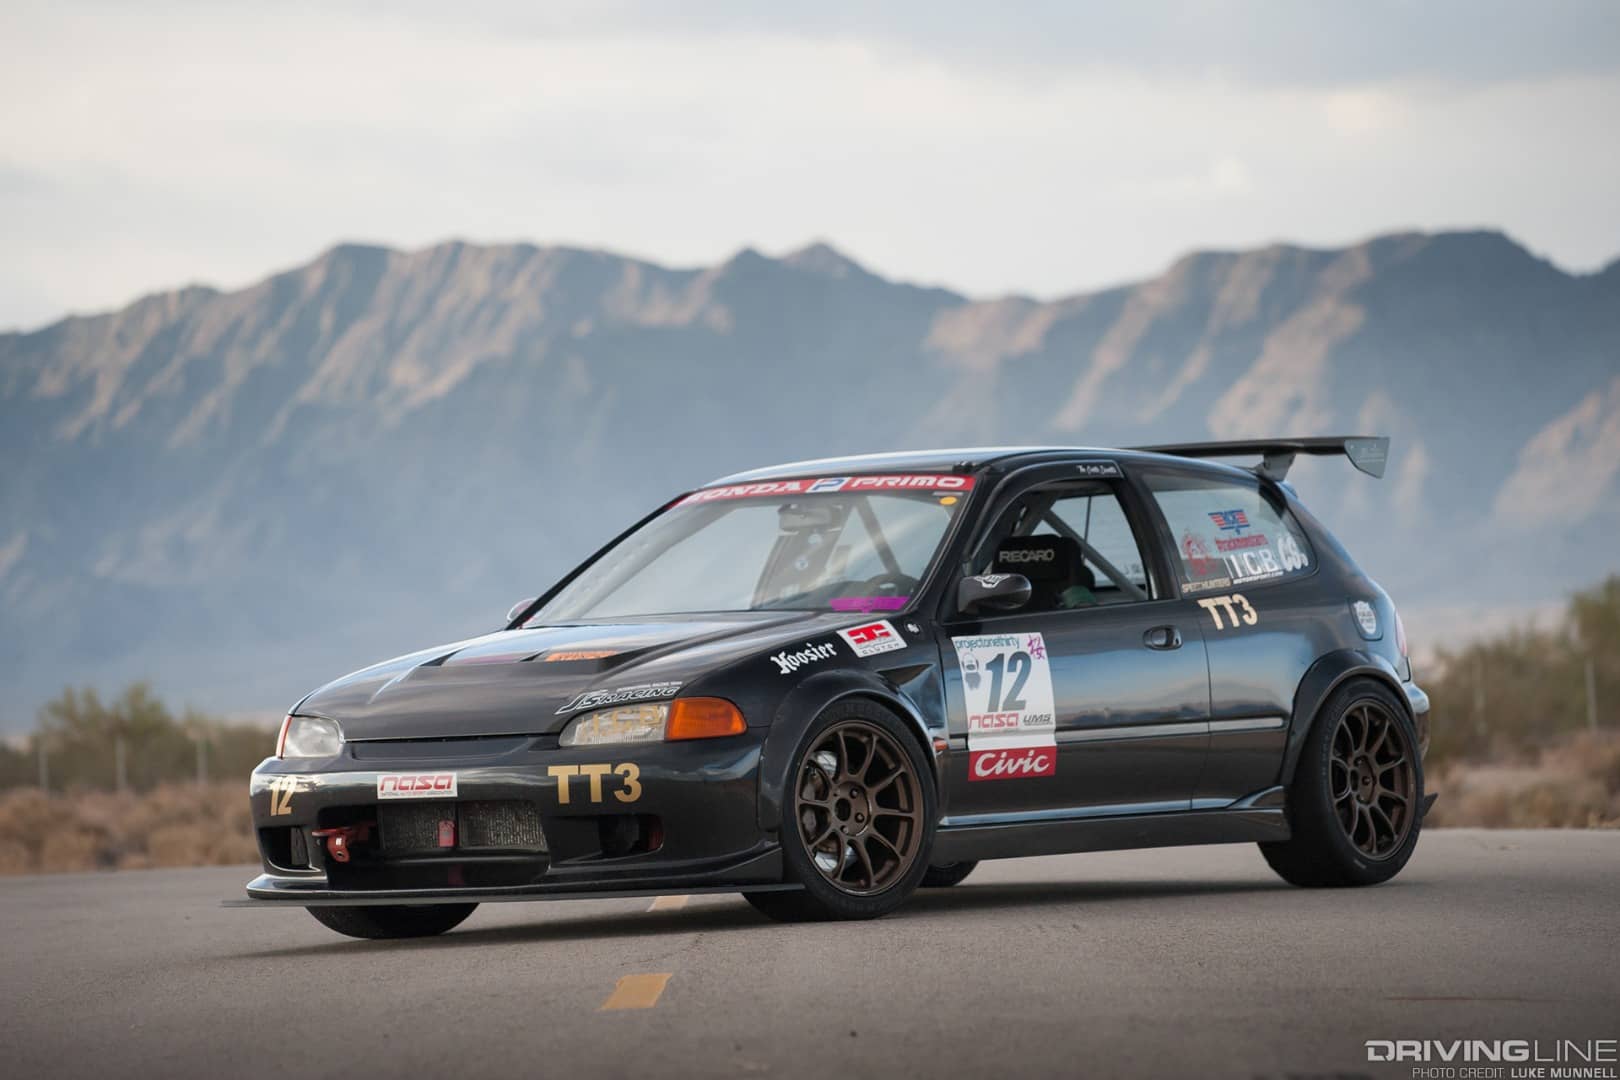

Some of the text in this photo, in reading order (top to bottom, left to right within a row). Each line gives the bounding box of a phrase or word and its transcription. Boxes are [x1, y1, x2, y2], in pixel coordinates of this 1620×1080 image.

[851, 475, 965, 488] PRIMO
[999, 550, 1055, 563] RECARO
[1197, 593, 1258, 631] TT3
[770, 642, 838, 675] Hoosier
[985, 651, 1032, 712] 12
[975, 750, 1050, 777] Civic
[269, 775, 297, 816] 12
[547, 762, 643, 805] TT3
